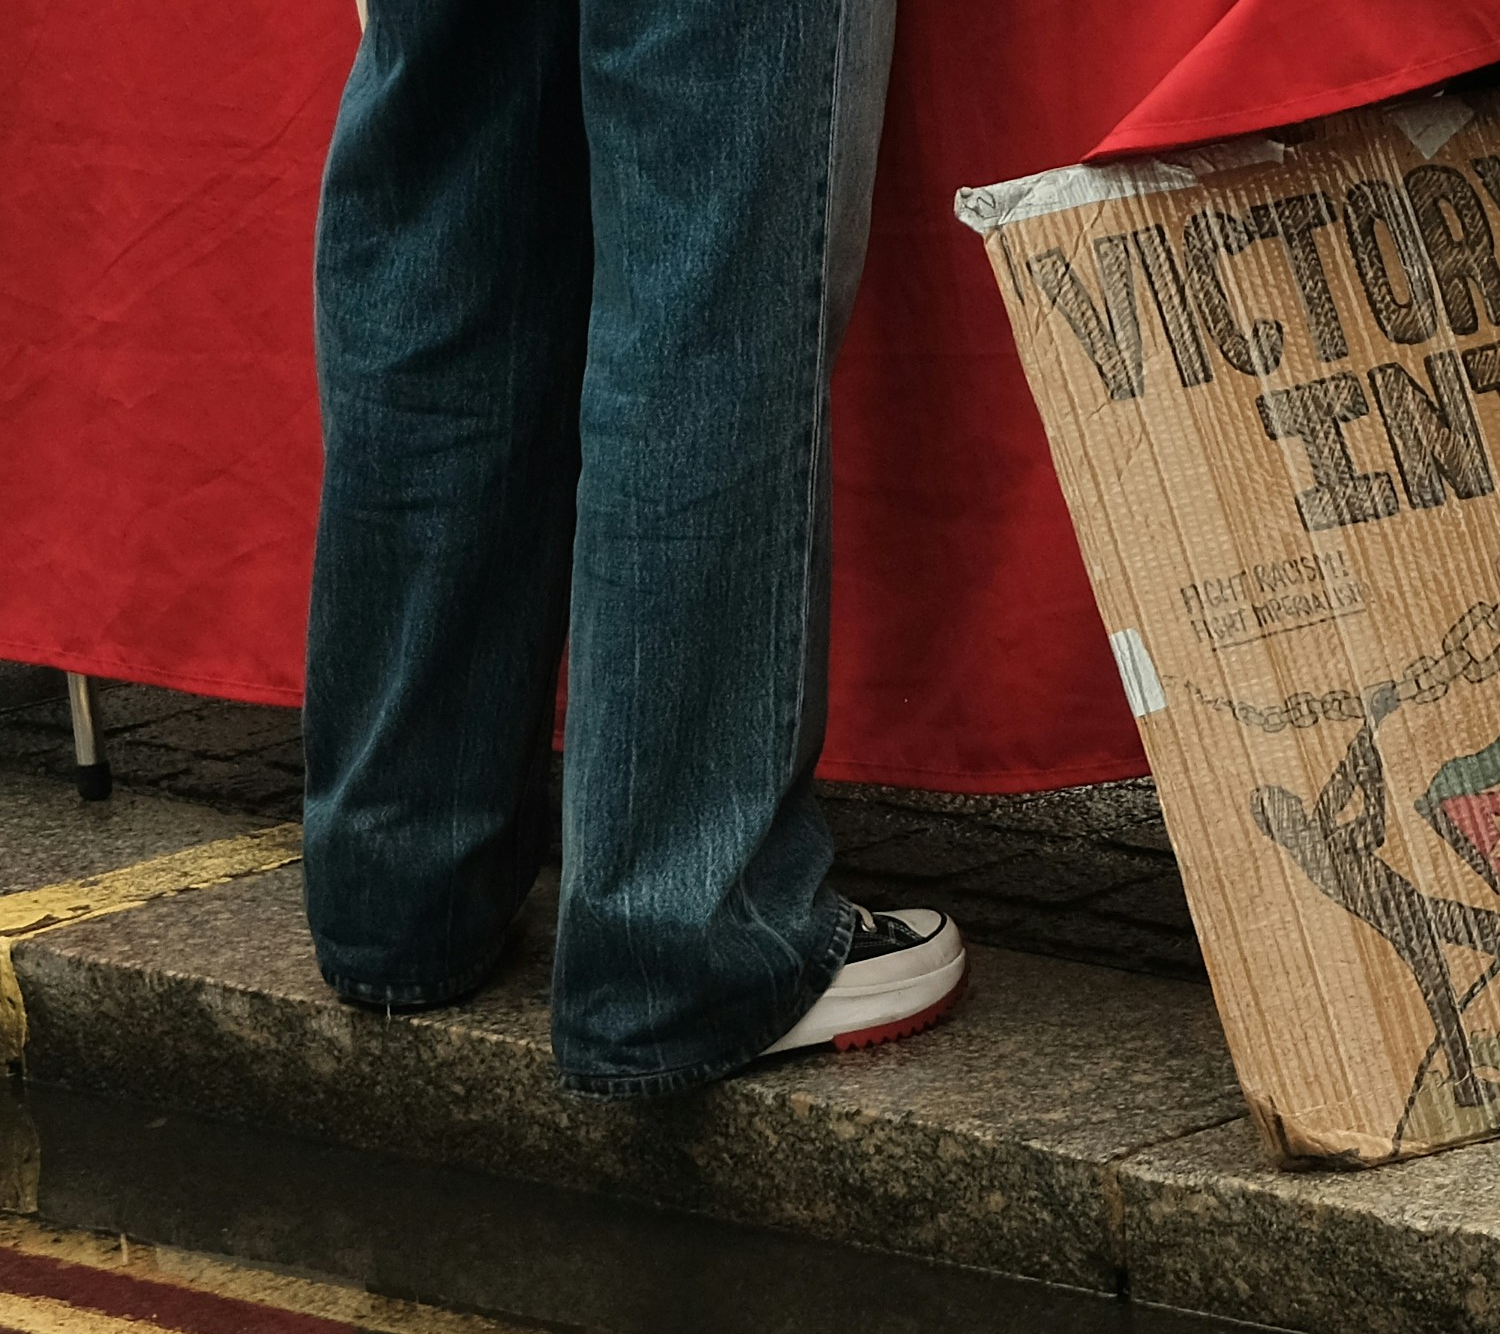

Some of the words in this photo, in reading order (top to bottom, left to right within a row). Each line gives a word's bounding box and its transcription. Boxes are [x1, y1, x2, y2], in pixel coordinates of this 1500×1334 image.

[1180, 569, 1247, 615] FIGHT
[1253, 550, 1350, 593] RACISM!
[1190, 608, 1247, 643] FIGHT
